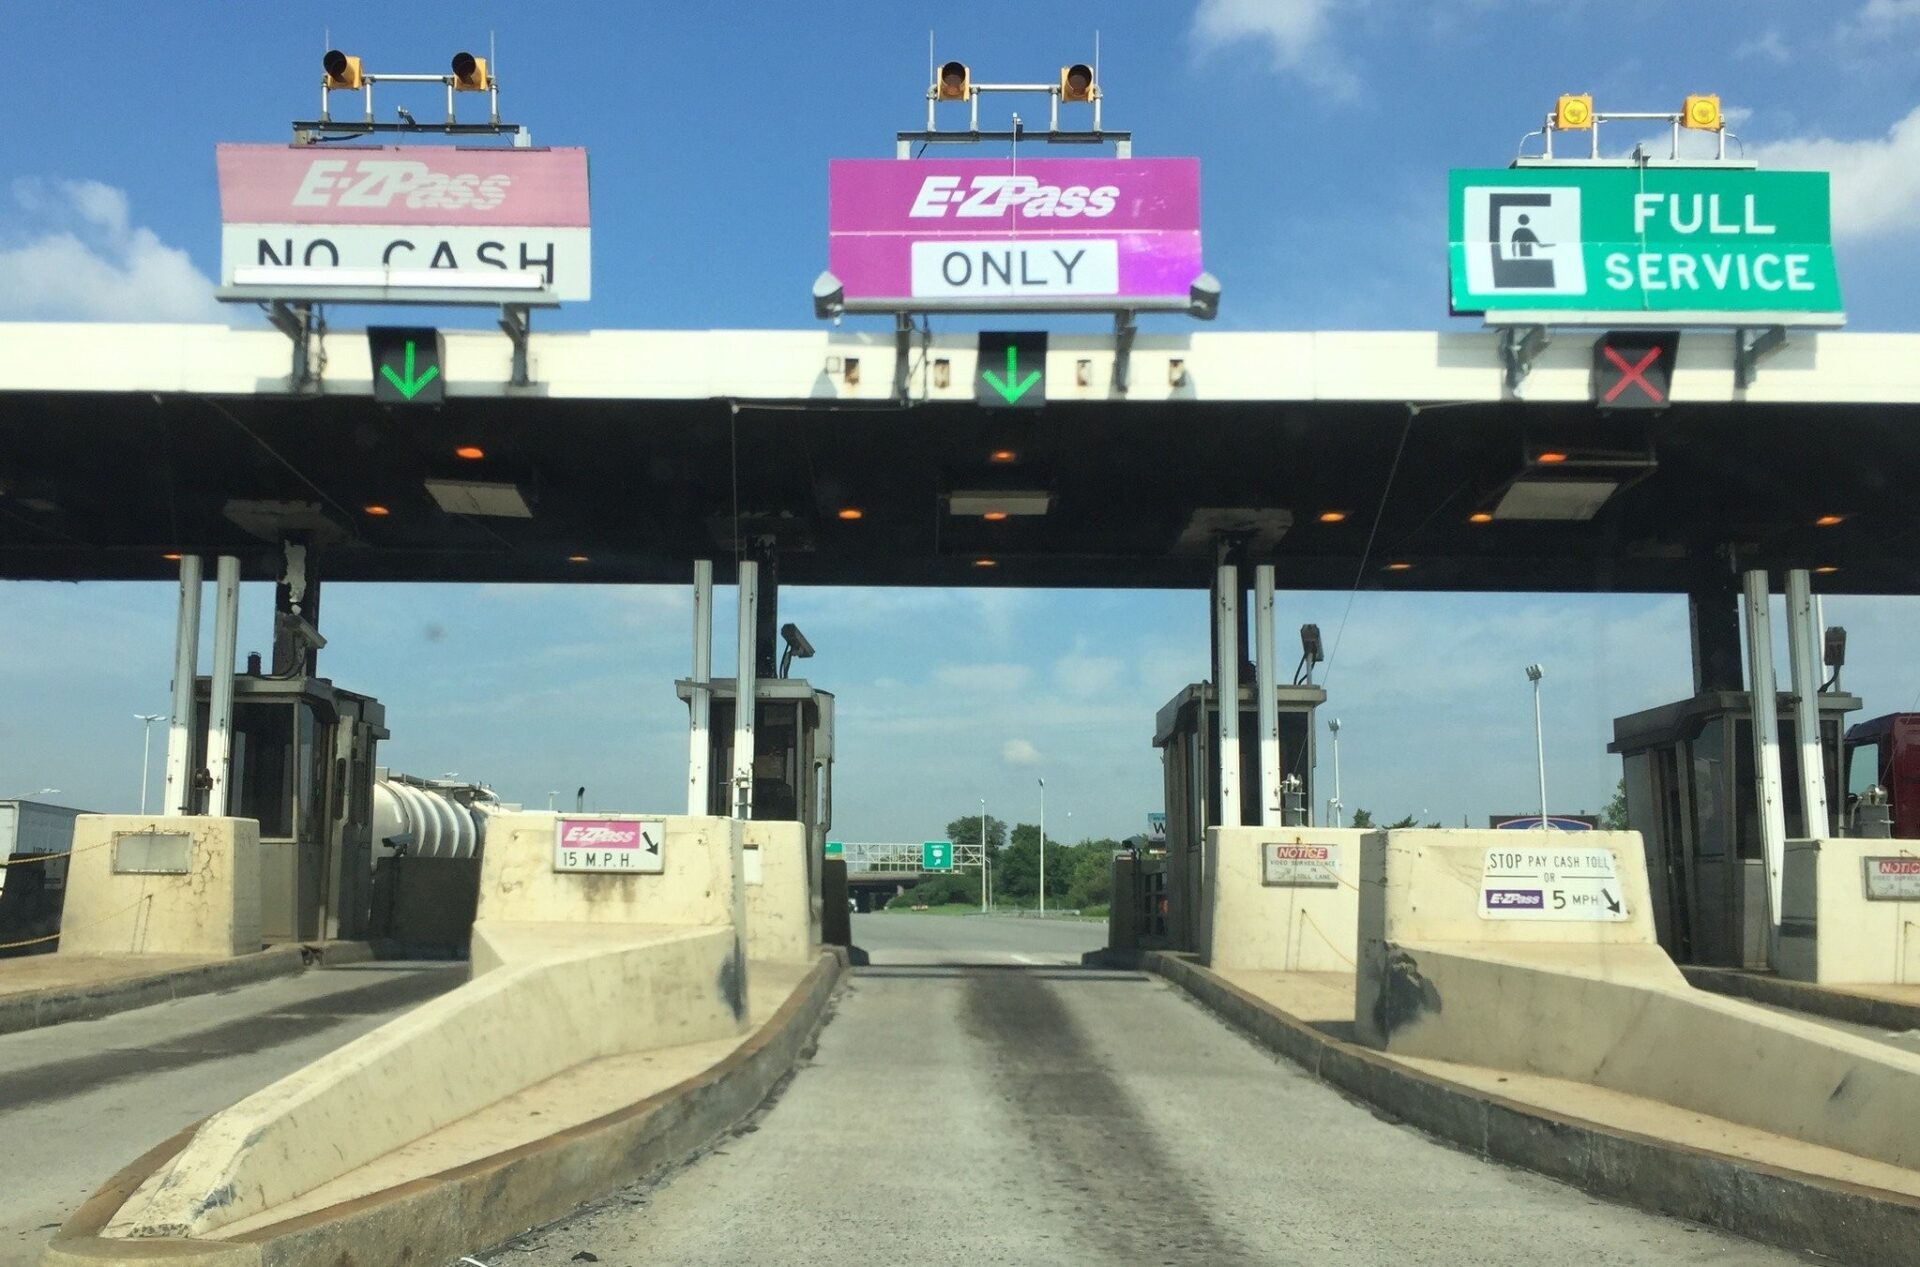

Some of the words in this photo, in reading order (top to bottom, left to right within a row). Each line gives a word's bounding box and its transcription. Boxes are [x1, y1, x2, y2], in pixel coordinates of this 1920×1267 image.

[291, 159, 511, 210] E-ZPass
[908, 175, 1120, 218] E-ZPass
[1634, 193, 1776, 234] FULL
[258, 238, 339, 267] NO
[382, 239, 554, 284] CASH
[942, 250, 1086, 287] ONLY
[1605, 252, 1815, 291] SERVICE
[563, 826, 636, 843] E-ZPass
[563, 851, 577, 867] 15
[1279, 847, 1326, 859] NOTICE
[1490, 853, 1522, 869] STOP
[1528, 855, 1547, 868] PAY
[1554, 855, 1580, 868] CASH
[1586, 856, 1609, 869] TOLL
[1881, 862, 1920, 873] NOTIC
[1544, 872, 1555, 883] OR
[1490, 893, 1540, 905] E-ZPass
[1553, 890, 1566, 909] 5
[1573, 895, 1599, 905] MPH
